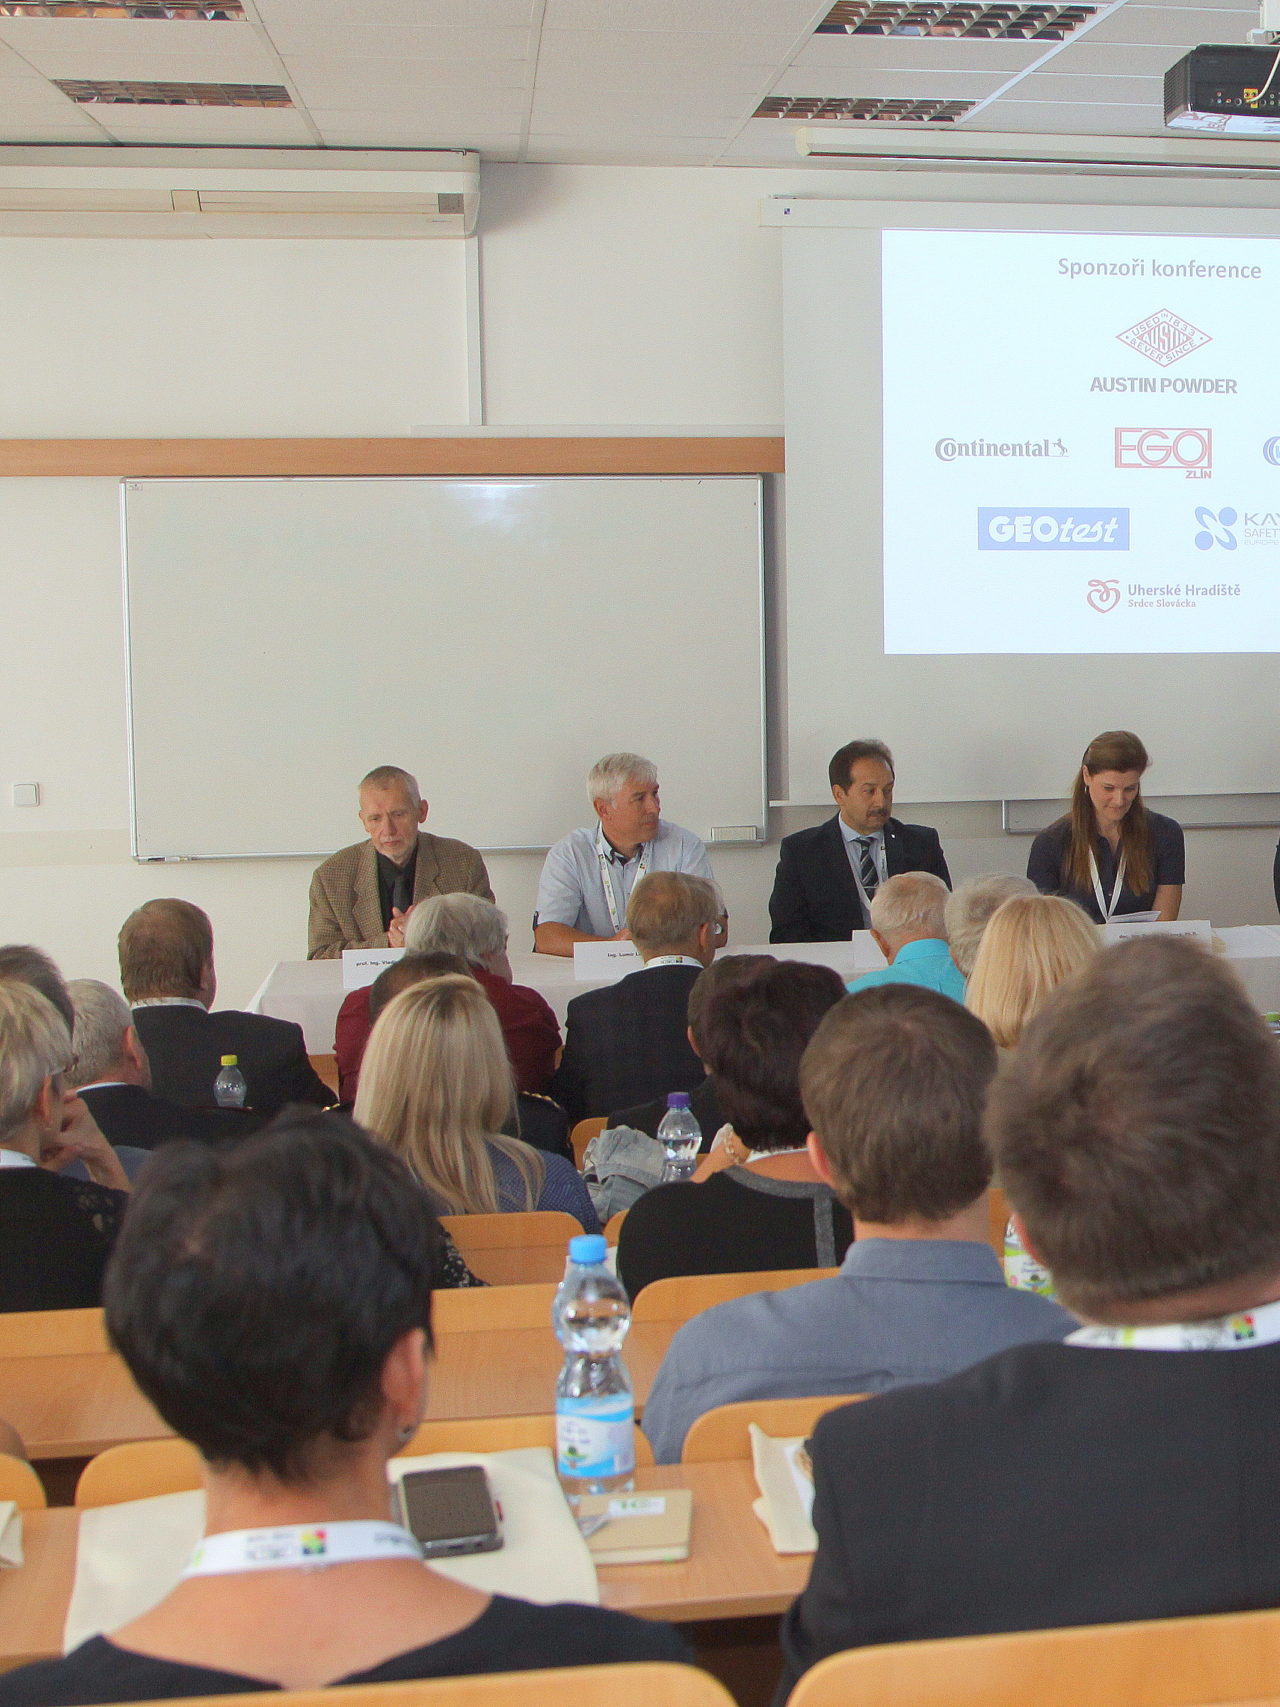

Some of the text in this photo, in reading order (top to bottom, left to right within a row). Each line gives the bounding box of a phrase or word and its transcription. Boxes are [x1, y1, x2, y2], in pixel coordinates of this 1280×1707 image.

[1058, 257, 1262, 279] Sponzoři konference
[1132, 316, 1160, 336] USED
[1168, 316, 1196, 337] 1833
[1165, 340, 1197, 361] SINCE
[1090, 377, 1238, 394] AUSTIN POWDER
[935, 438, 1050, 461] Continental
[1115, 428, 1208, 468] EGO
[989, 516, 1119, 543] GEOtest
[1128, 583, 1241, 596] Uherské Hradiště
[1128, 599, 1197, 608] Srdce Slovácka
